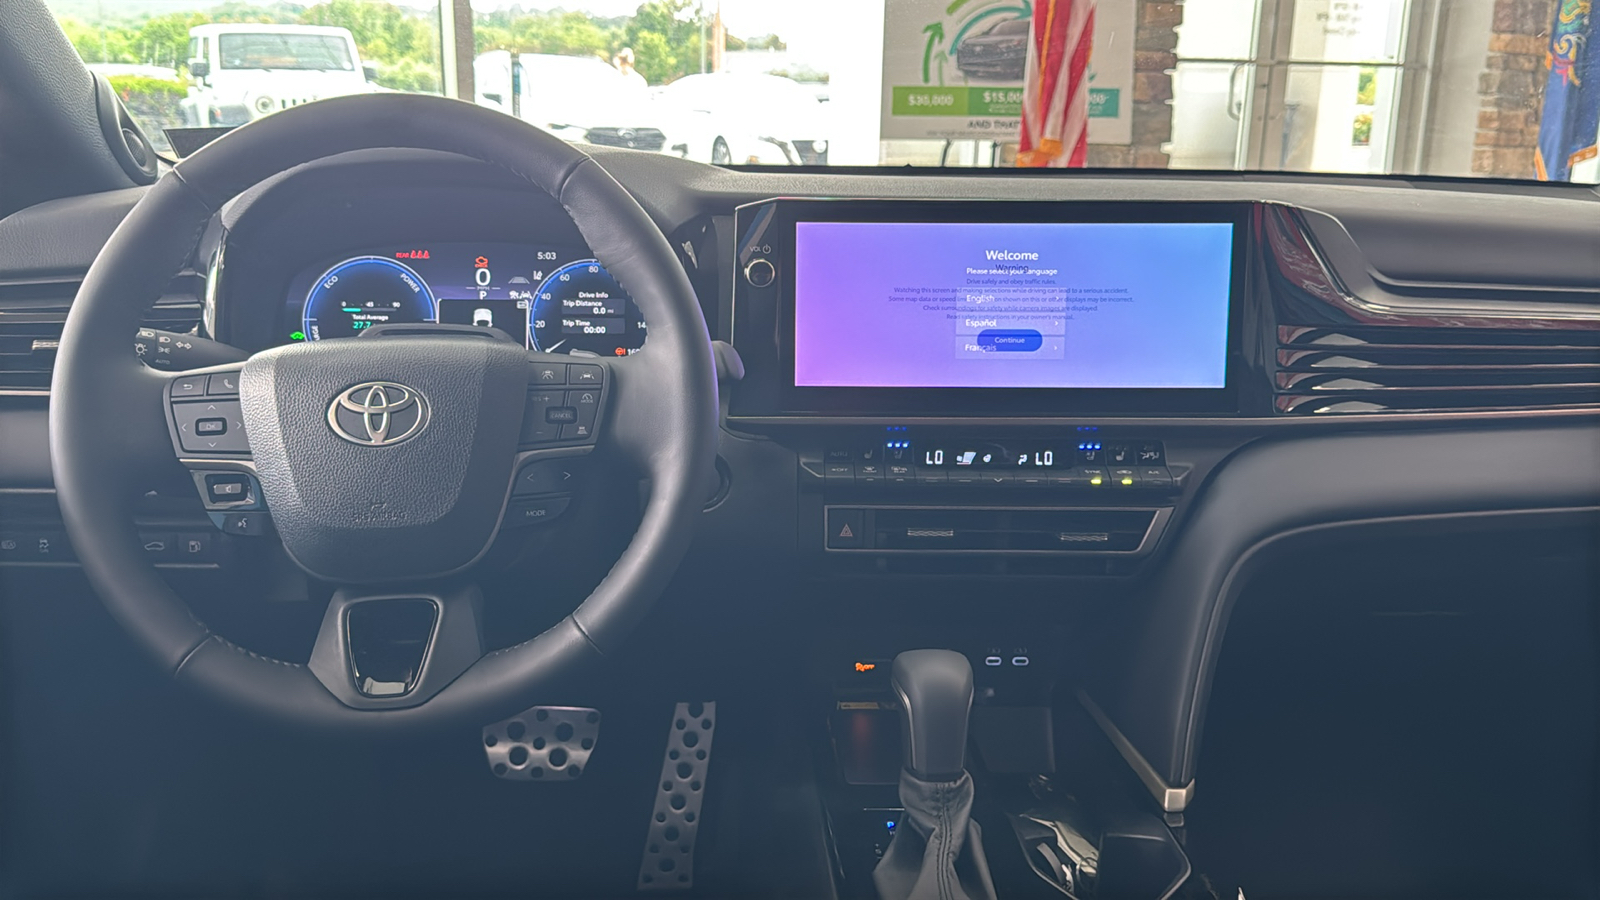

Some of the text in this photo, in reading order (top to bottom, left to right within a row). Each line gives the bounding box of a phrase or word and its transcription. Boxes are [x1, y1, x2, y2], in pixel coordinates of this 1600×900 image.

[908, 94, 954, 107] $30,000
[983, 90, 1022, 104] $15,00
[537, 252, 556, 260] 5:03
[986, 250, 1038, 260] Welcome
[995, 264, 1029, 274] Warning
[1026, 268, 1058, 276] language
[323, 275, 338, 289] ECO
[476, 268, 491, 286] 0
[982, 278, 998, 286] safely
[1010, 278, 1024, 286] obey
[400, 273, 420, 293] POWER
[479, 291, 488, 300] P
[966, 294, 994, 304] English
[352, 321, 371, 329] 27.7
[966, 318, 997, 328] Español
[965, 344, 996, 353] Français
